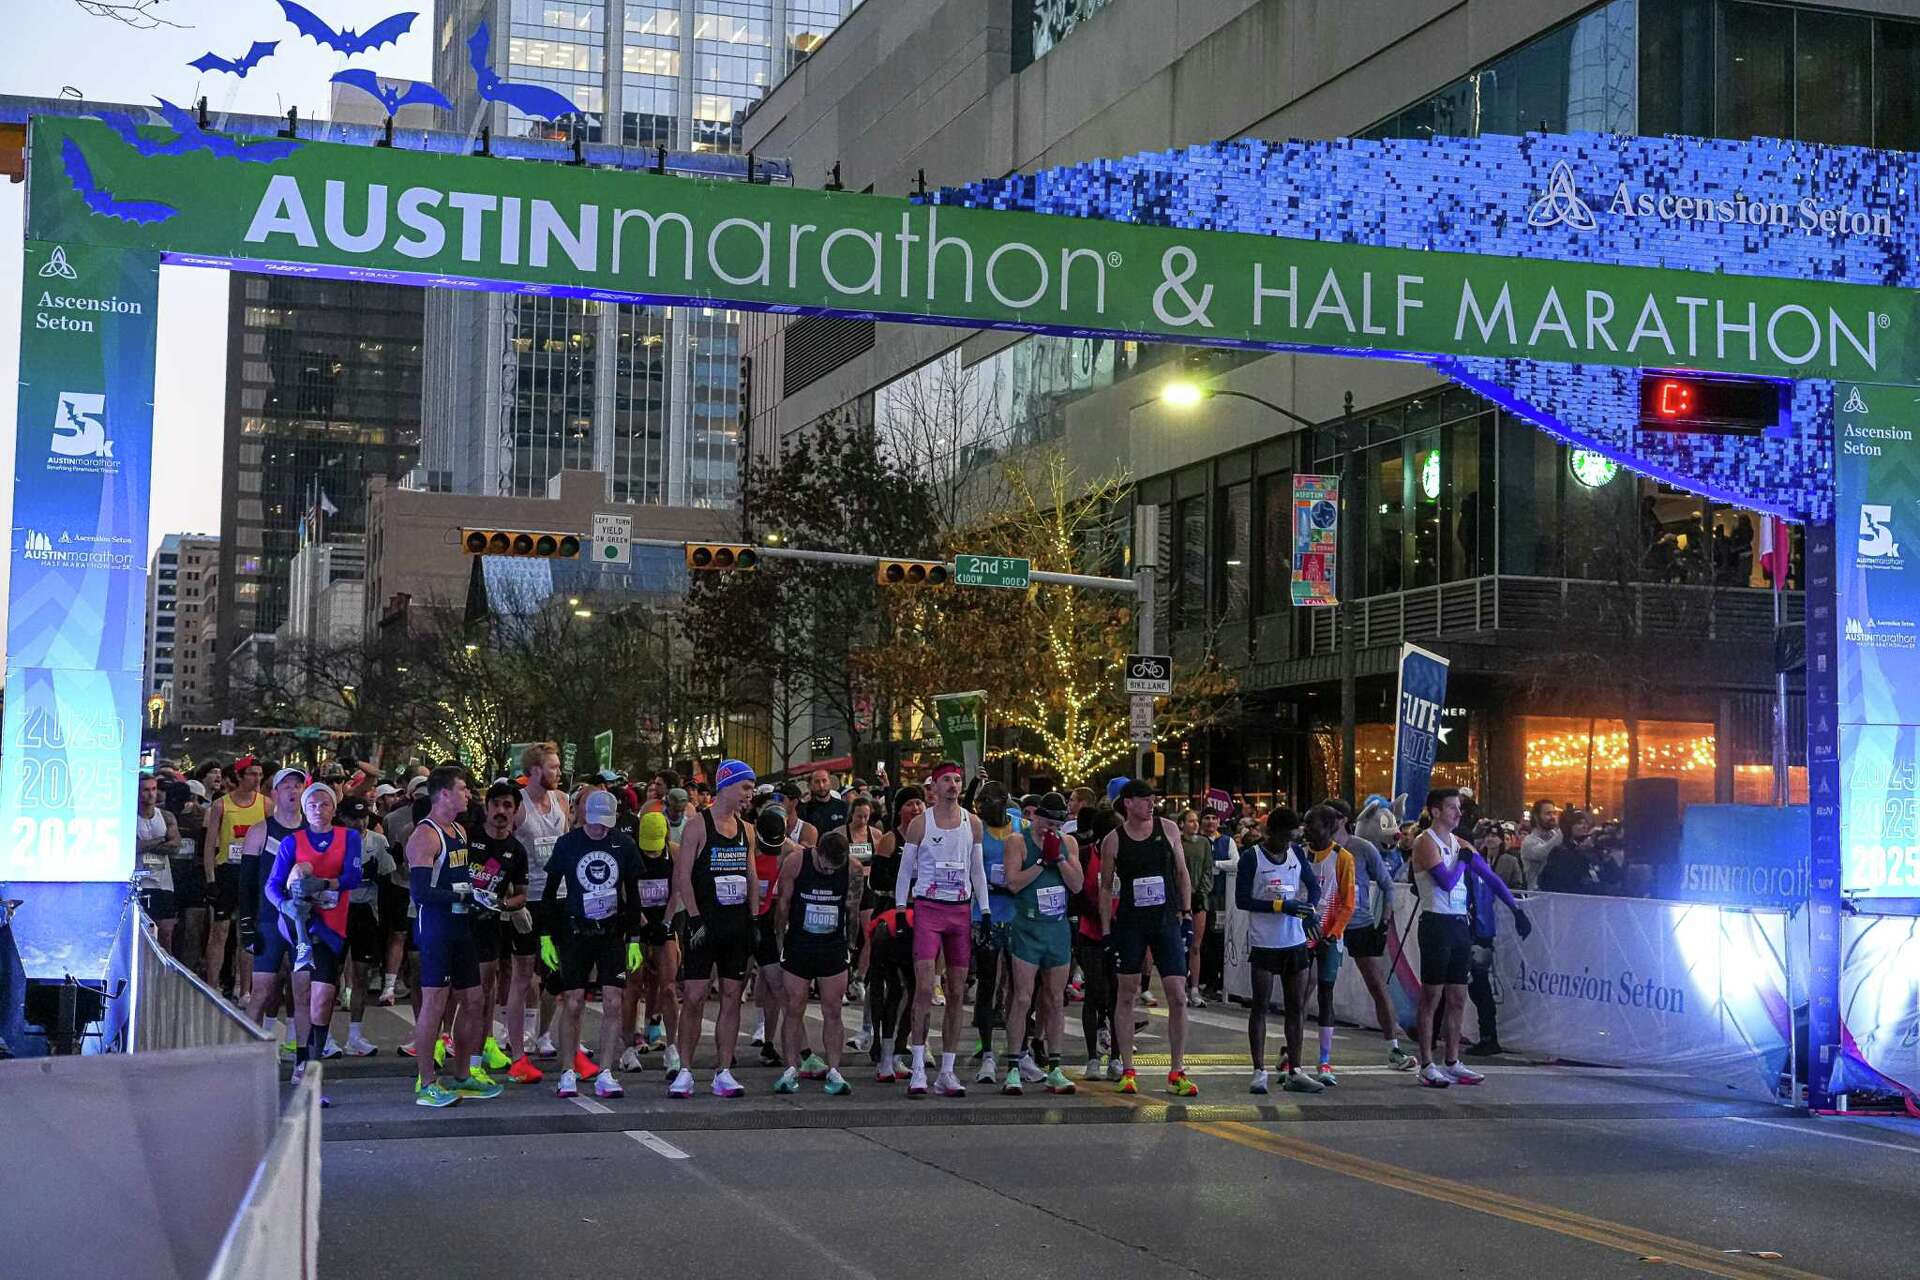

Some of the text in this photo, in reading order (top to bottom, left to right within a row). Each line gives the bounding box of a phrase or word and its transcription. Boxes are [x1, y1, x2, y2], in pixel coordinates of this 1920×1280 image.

[1609, 182, 1893, 237] Ascension Seton
[1152, 245, 1214, 327] &
[1253, 263, 1424, 337] HALF
[38, 291, 142, 315] Ascension
[35, 313, 94, 333] Seton
[1843, 423, 1913, 440] Ascension
[1843, 441, 1882, 456] Seton
[602, 525, 623, 535] YIELD
[608, 536, 628, 544] GREEN
[970, 557, 1016, 574] 2nd ST
[963, 574, 1021, 587] 100W 100E
[1130, 681, 1166, 691] BIKE LANE
[1207, 797, 1229, 812] STOP
[10, 816, 121, 866] 2025
[1512, 960, 1685, 1014] Ascension Seton
